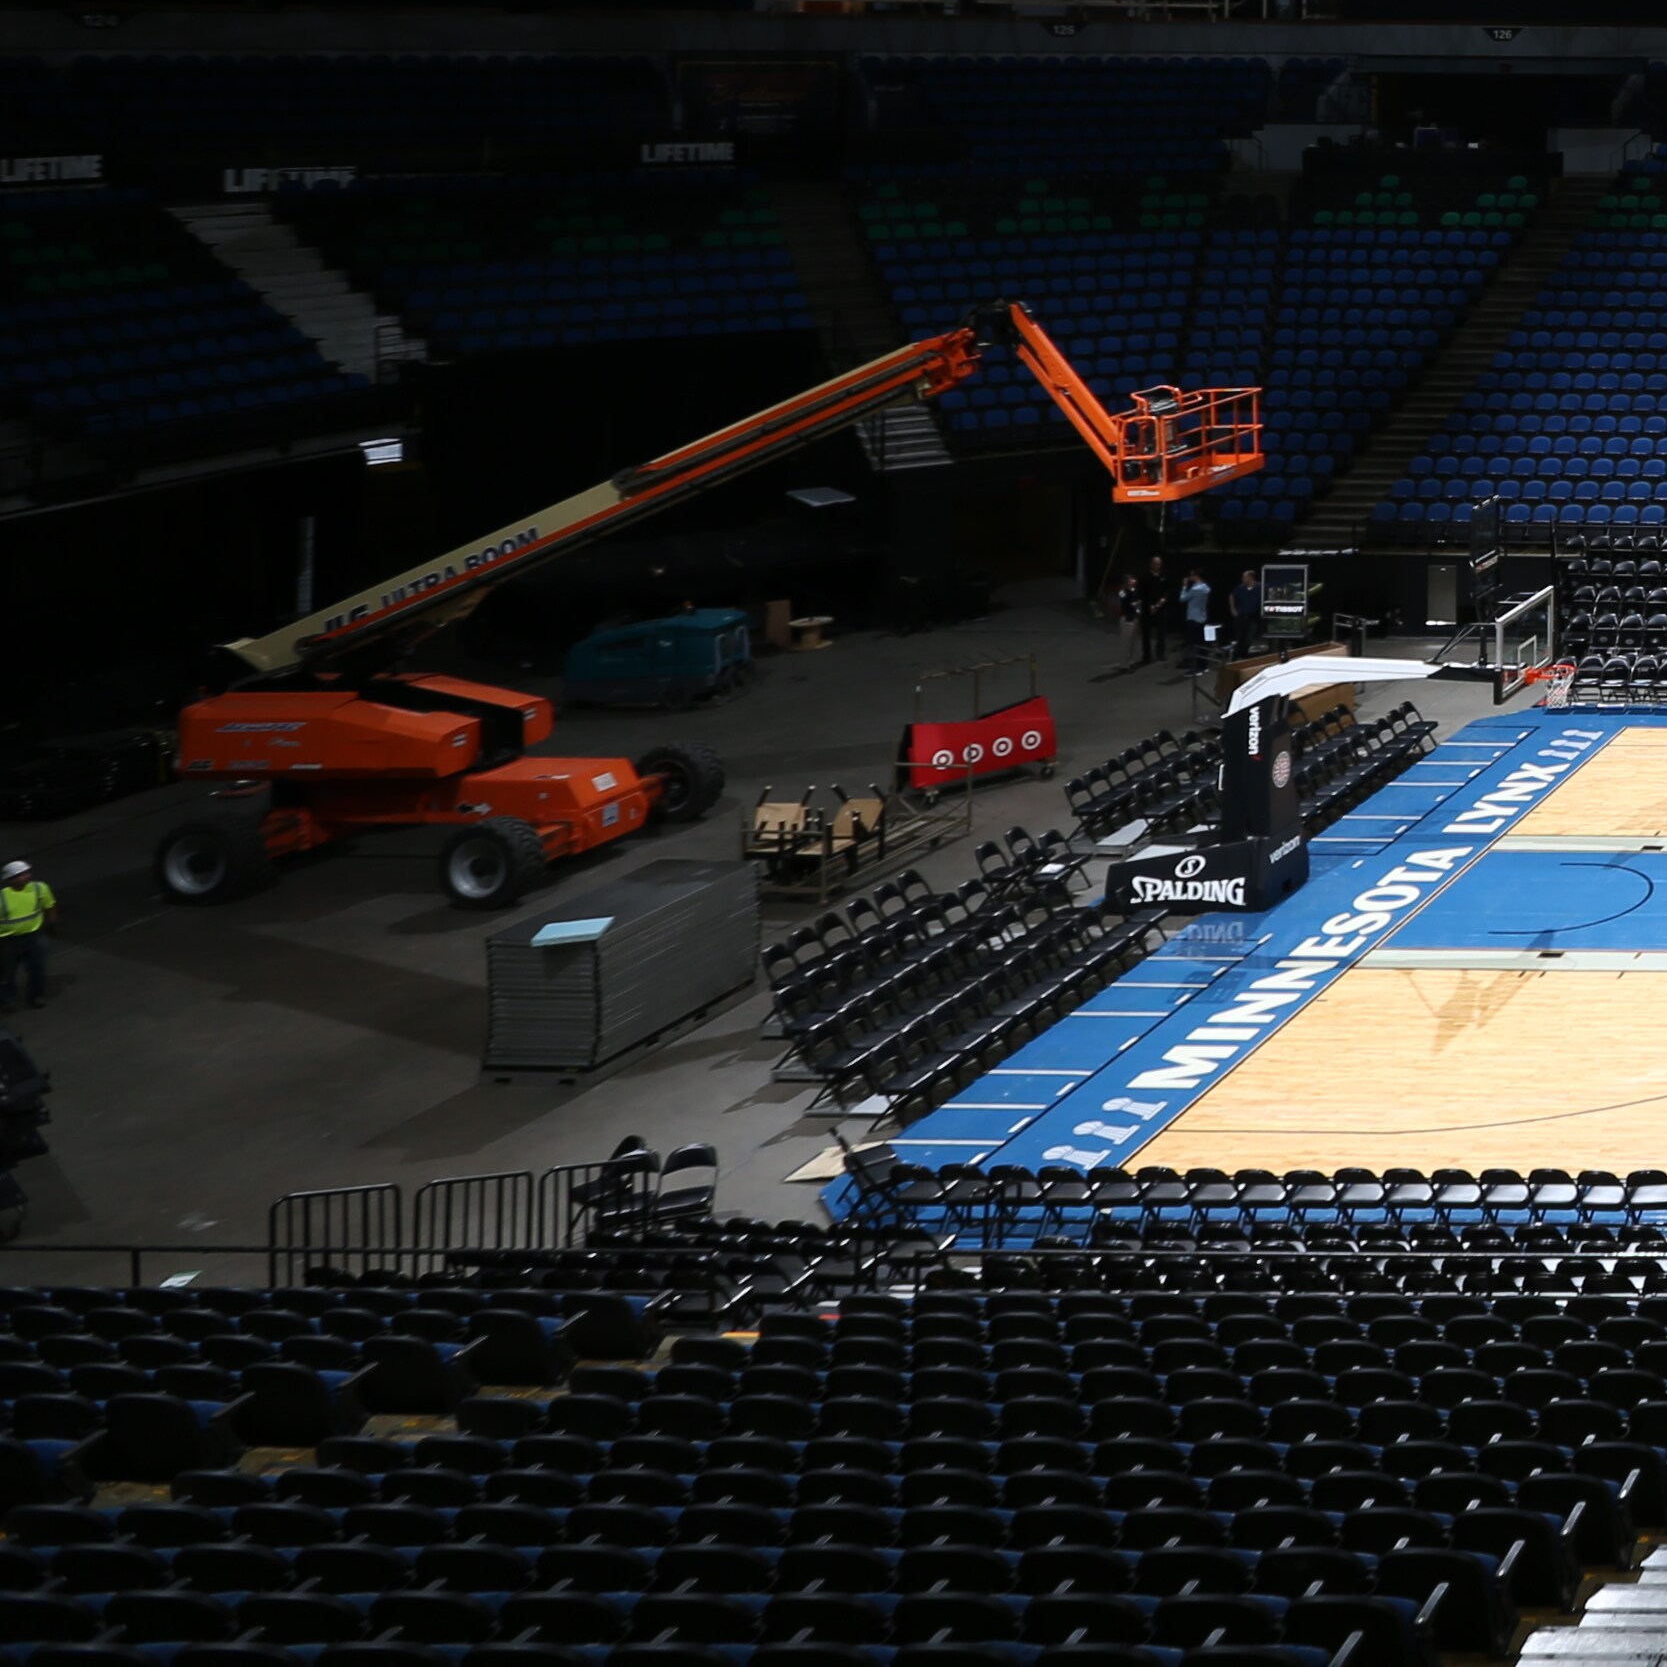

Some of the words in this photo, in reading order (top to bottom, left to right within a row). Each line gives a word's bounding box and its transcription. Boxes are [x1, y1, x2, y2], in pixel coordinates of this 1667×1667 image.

[640, 142, 736, 163] LIFETIME
[1248, 705, 1262, 756] verizon
[1268, 834, 1301, 865] verizon
[1130, 875, 1247, 907] SPALDING
[1126, 845, 1473, 1090] MINNESOTA
[1441, 761, 1557, 834] LYNX
